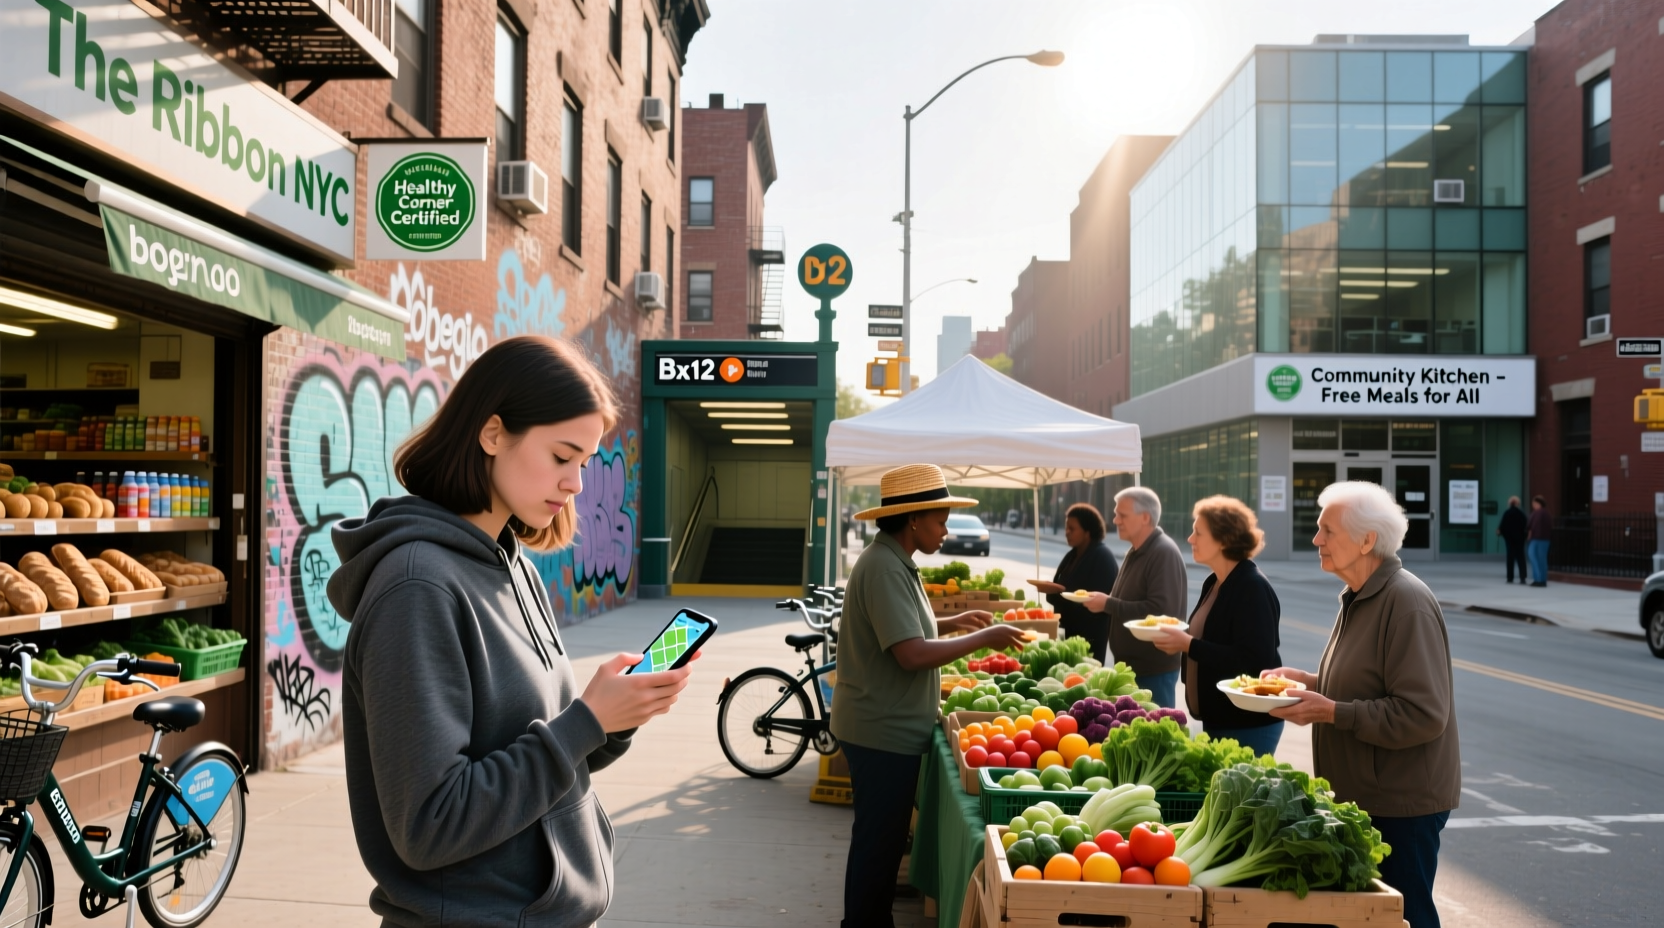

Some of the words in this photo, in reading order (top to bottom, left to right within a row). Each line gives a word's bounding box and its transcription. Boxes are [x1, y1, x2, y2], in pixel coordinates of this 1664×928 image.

[34, 0, 138, 116] The
[152, 58, 286, 197] Ribbon
[294, 154, 350, 227] NYC
[394, 179, 457, 198] Healthy
[398, 195, 454, 209] Corner
[390, 210, 460, 225] Certified
[659, 358, 715, 381] Bx12
[1311, 367, 1416, 387] Community
[1421, 367, 1490, 384] Kitchen
[1321, 387, 1361, 403] Free
[1367, 387, 1419, 404] Meals
[1423, 386, 1451, 404] for
[1456, 387, 1480, 404] All
